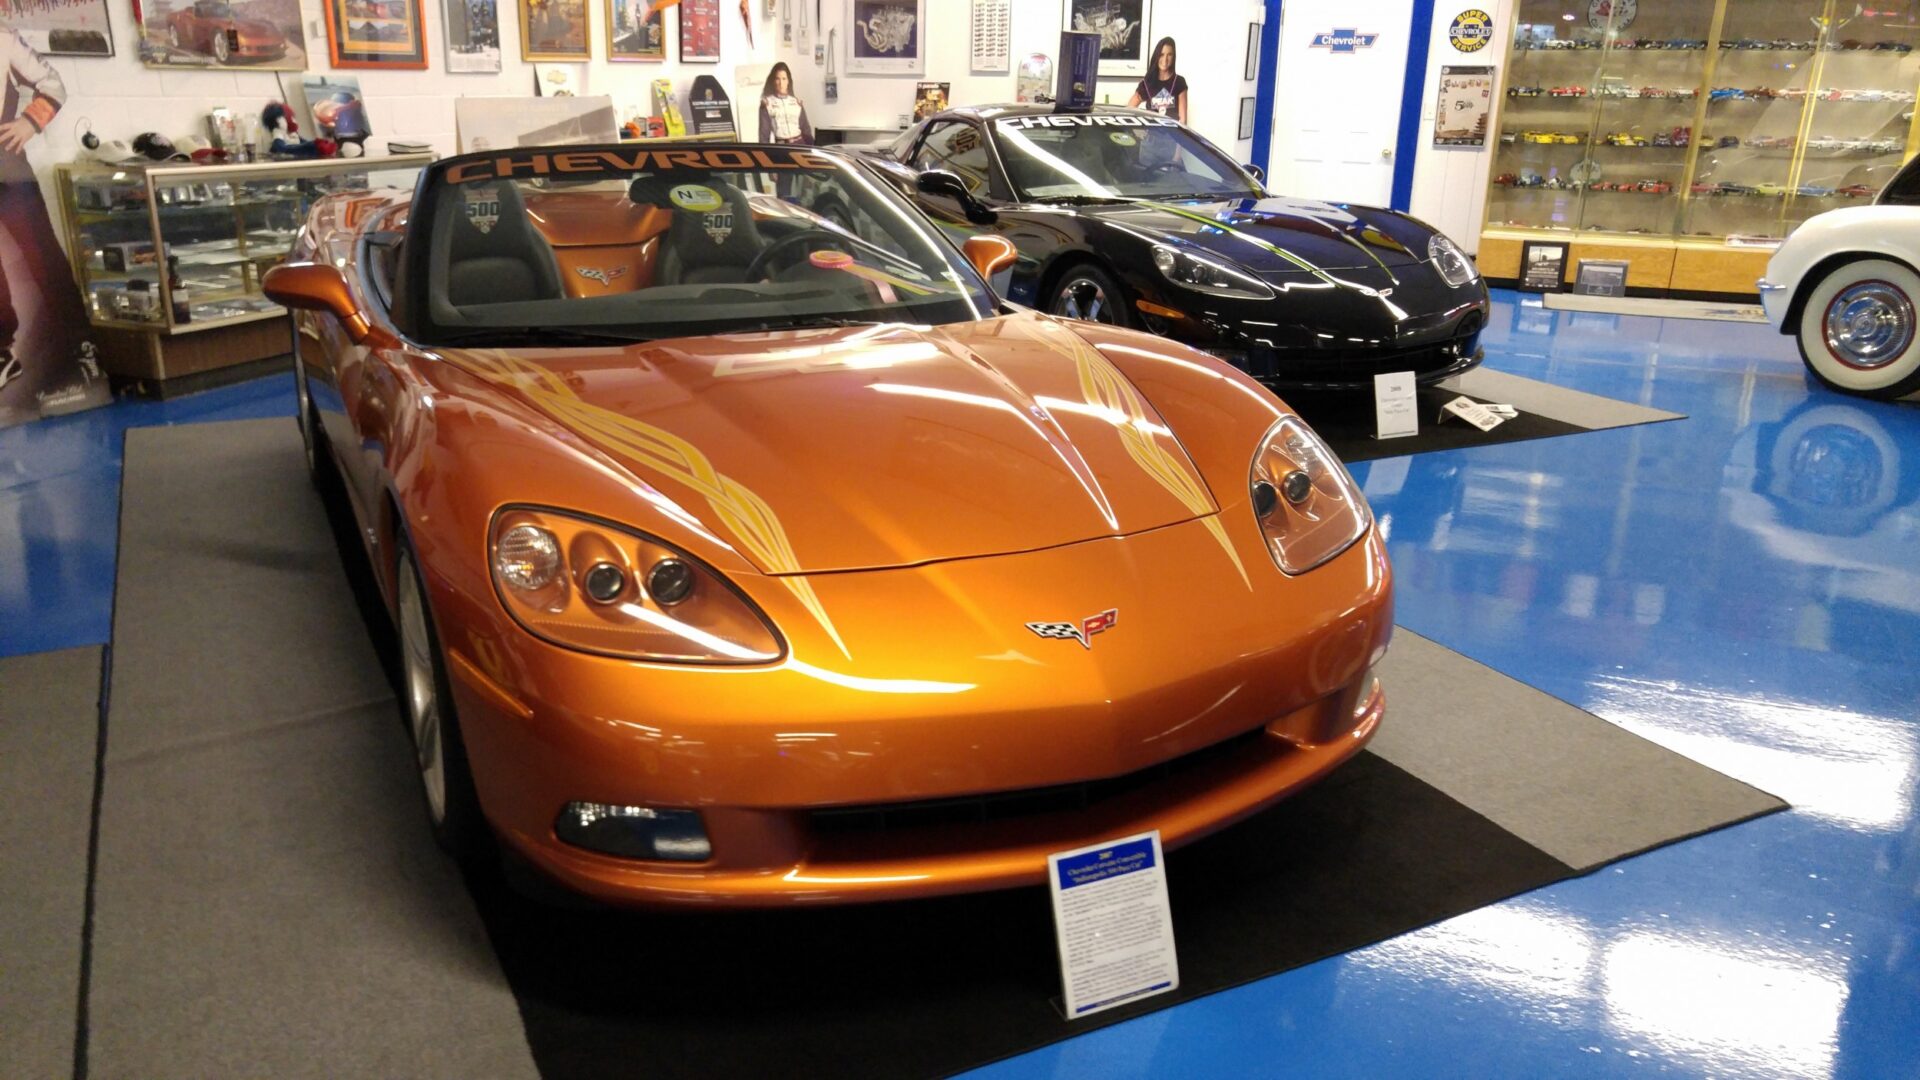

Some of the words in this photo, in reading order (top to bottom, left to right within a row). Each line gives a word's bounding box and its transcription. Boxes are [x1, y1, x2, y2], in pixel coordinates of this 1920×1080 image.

[1457, 10, 1488, 22] SUPER
[1450, 27, 1491, 36] CHEVROLET
[1321, 35, 1366, 45] Chevrolet
[1452, 38, 1487, 51] SERVICE
[996, 115, 1179, 131] CHEVROLE
[446, 151, 837, 184] CHEVROLE
[466, 202, 500, 217] 500
[703, 214, 733, 229] 500
